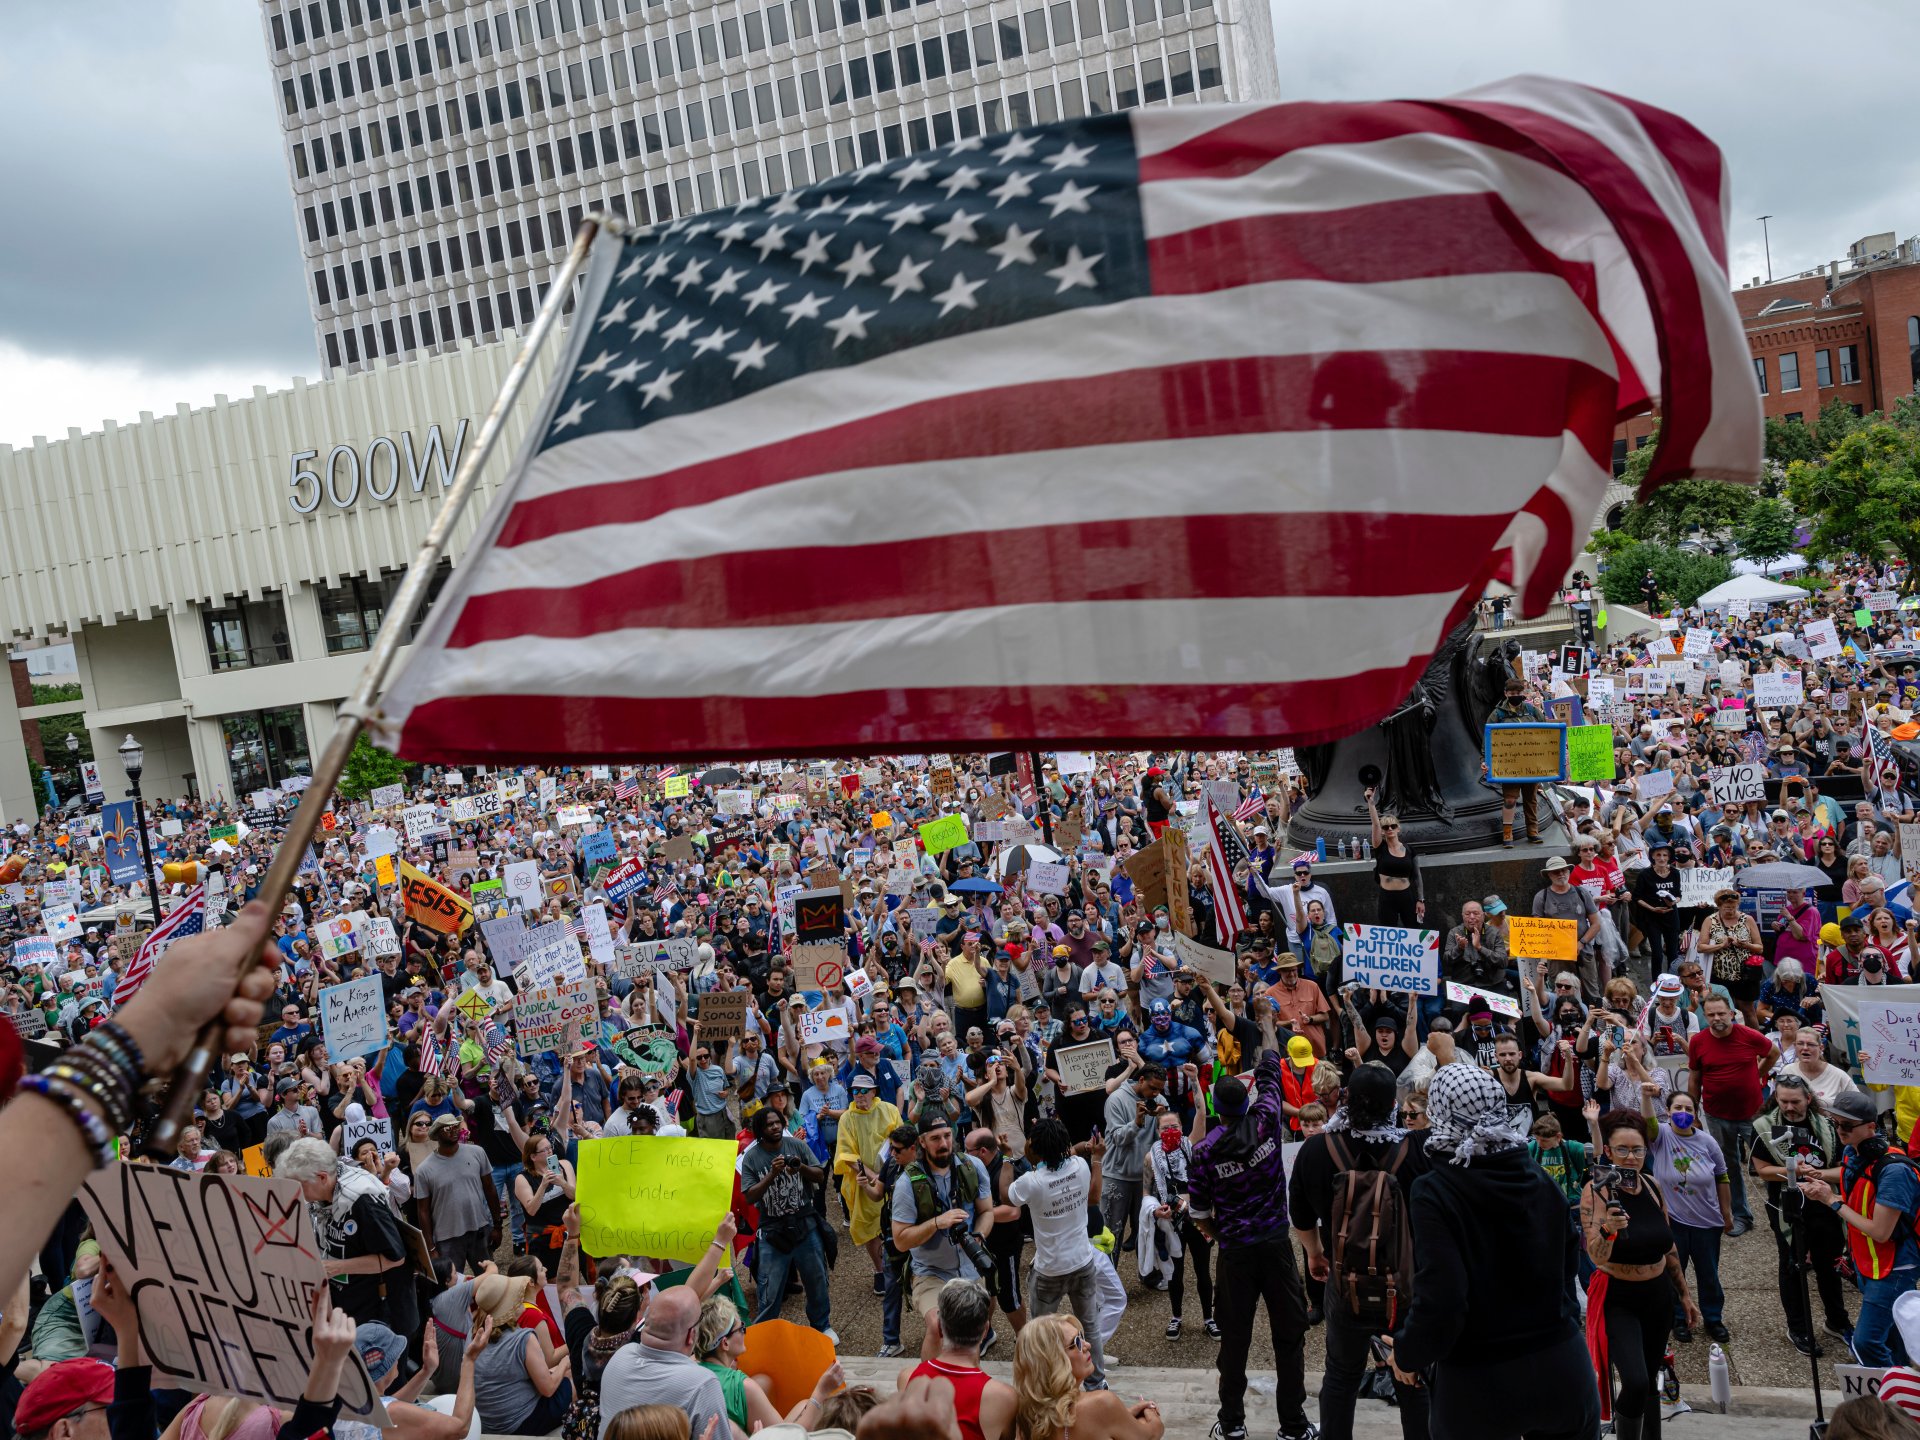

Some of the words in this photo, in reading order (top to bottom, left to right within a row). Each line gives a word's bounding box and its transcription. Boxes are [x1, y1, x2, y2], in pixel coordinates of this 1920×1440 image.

[288, 418, 470, 513] 500W
[1757, 676, 1775, 685] THIS
[1555, 704, 1570, 712] FDT
[1759, 696, 1799, 705] DEMOCRACY
[505, 778, 518, 787] NO
[1729, 768, 1753, 784] NO
[474, 793, 498, 807] FUCK
[1714, 783, 1765, 803] KINGS
[479, 802, 498, 814] ICE
[404, 812, 417, 821] YOU
[714, 834, 724, 843] NO
[727, 827, 746, 838] KINGS
[931, 826, 957, 842] FASCISM
[1164, 830, 1183, 848] NO
[896, 840, 912, 851] STOP
[596, 854, 616, 865] MASS
[112, 865, 138, 874] Downtown
[1696, 869, 1731, 883] FASCISM
[514, 876, 531, 885] ICE
[608, 873, 646, 898] DEMOCRACY
[1656, 881, 1674, 889] VOTE
[1171, 848, 1186, 930] KINGS
[402, 874, 473, 923] RESIST
[329, 919, 352, 938] DO
[1526, 918, 1537, 928] the
[520, 923, 561, 942] HISTORY
[1370, 927, 1408, 942] STOP
[17, 938, 31, 947] THIS
[38, 935, 54, 944] WHAT
[367, 938, 400, 956] FASCISM
[815, 935, 846, 950] KINGS
[1356, 939, 1424, 957] PUTTING
[17, 943, 54, 955] DEMOCRACY
[19, 951, 42, 962] LOOKS
[44, 950, 56, 958] LIKE
[522, 943, 538, 956] HAS
[532, 956, 544, 968] At
[545, 950, 562, 963] Most
[565, 941, 576, 952] he
[619, 964, 646, 978] HURTS
[651, 963, 666, 972] NO
[669, 959, 690, 970] ONE
[1346, 954, 1421, 973] CHILDREN
[535, 967, 556, 980] deserves
[1354, 972, 1370, 986] IN
[1380, 974, 1431, 992] CAGES
[330, 994, 343, 1010] No
[349, 988, 376, 1002] Kings
[517, 992, 528, 1005] IT
[537, 989, 547, 1001] IS
[557, 981, 582, 996] NOT
[704, 995, 742, 1005] TODOS
[516, 998, 560, 1016] RADICAL
[571, 992, 588, 1003] TO
[517, 1012, 552, 1028] WANT
[561, 1004, 594, 1020] GOOD
[703, 1011, 742, 1022] SOMOS
[1886, 1010, 1912, 1024] Due
[519, 1024, 562, 1039] THINGS
[701, 1026, 740, 1038] FAMILIA
[804, 1027, 818, 1037] GO
[1909, 1041, 1917, 1052] 4
[1064, 1052, 1094, 1065] HISTORY
[1096, 1050, 1109, 1058] HAS
[1084, 1061, 1100, 1070] EYES
[1102, 1057, 1111, 1066] ON
[666, 1065, 679, 1082] FREE!
[1083, 1067, 1097, 1078] US
[1070, 1083, 1081, 1091] NO
[349, 1126, 366, 1138] NO
[367, 1122, 387, 1134] ONE
[598, 1141, 643, 1168] ICE
[665, 1151, 714, 1170] melts
[629, 1184, 678, 1201] under
[82, 1162, 258, 1309] VETO
[580, 1205, 716, 1252] Resistance
[261, 1271, 318, 1322] THE
[132, 1278, 374, 1415] CHEETO
